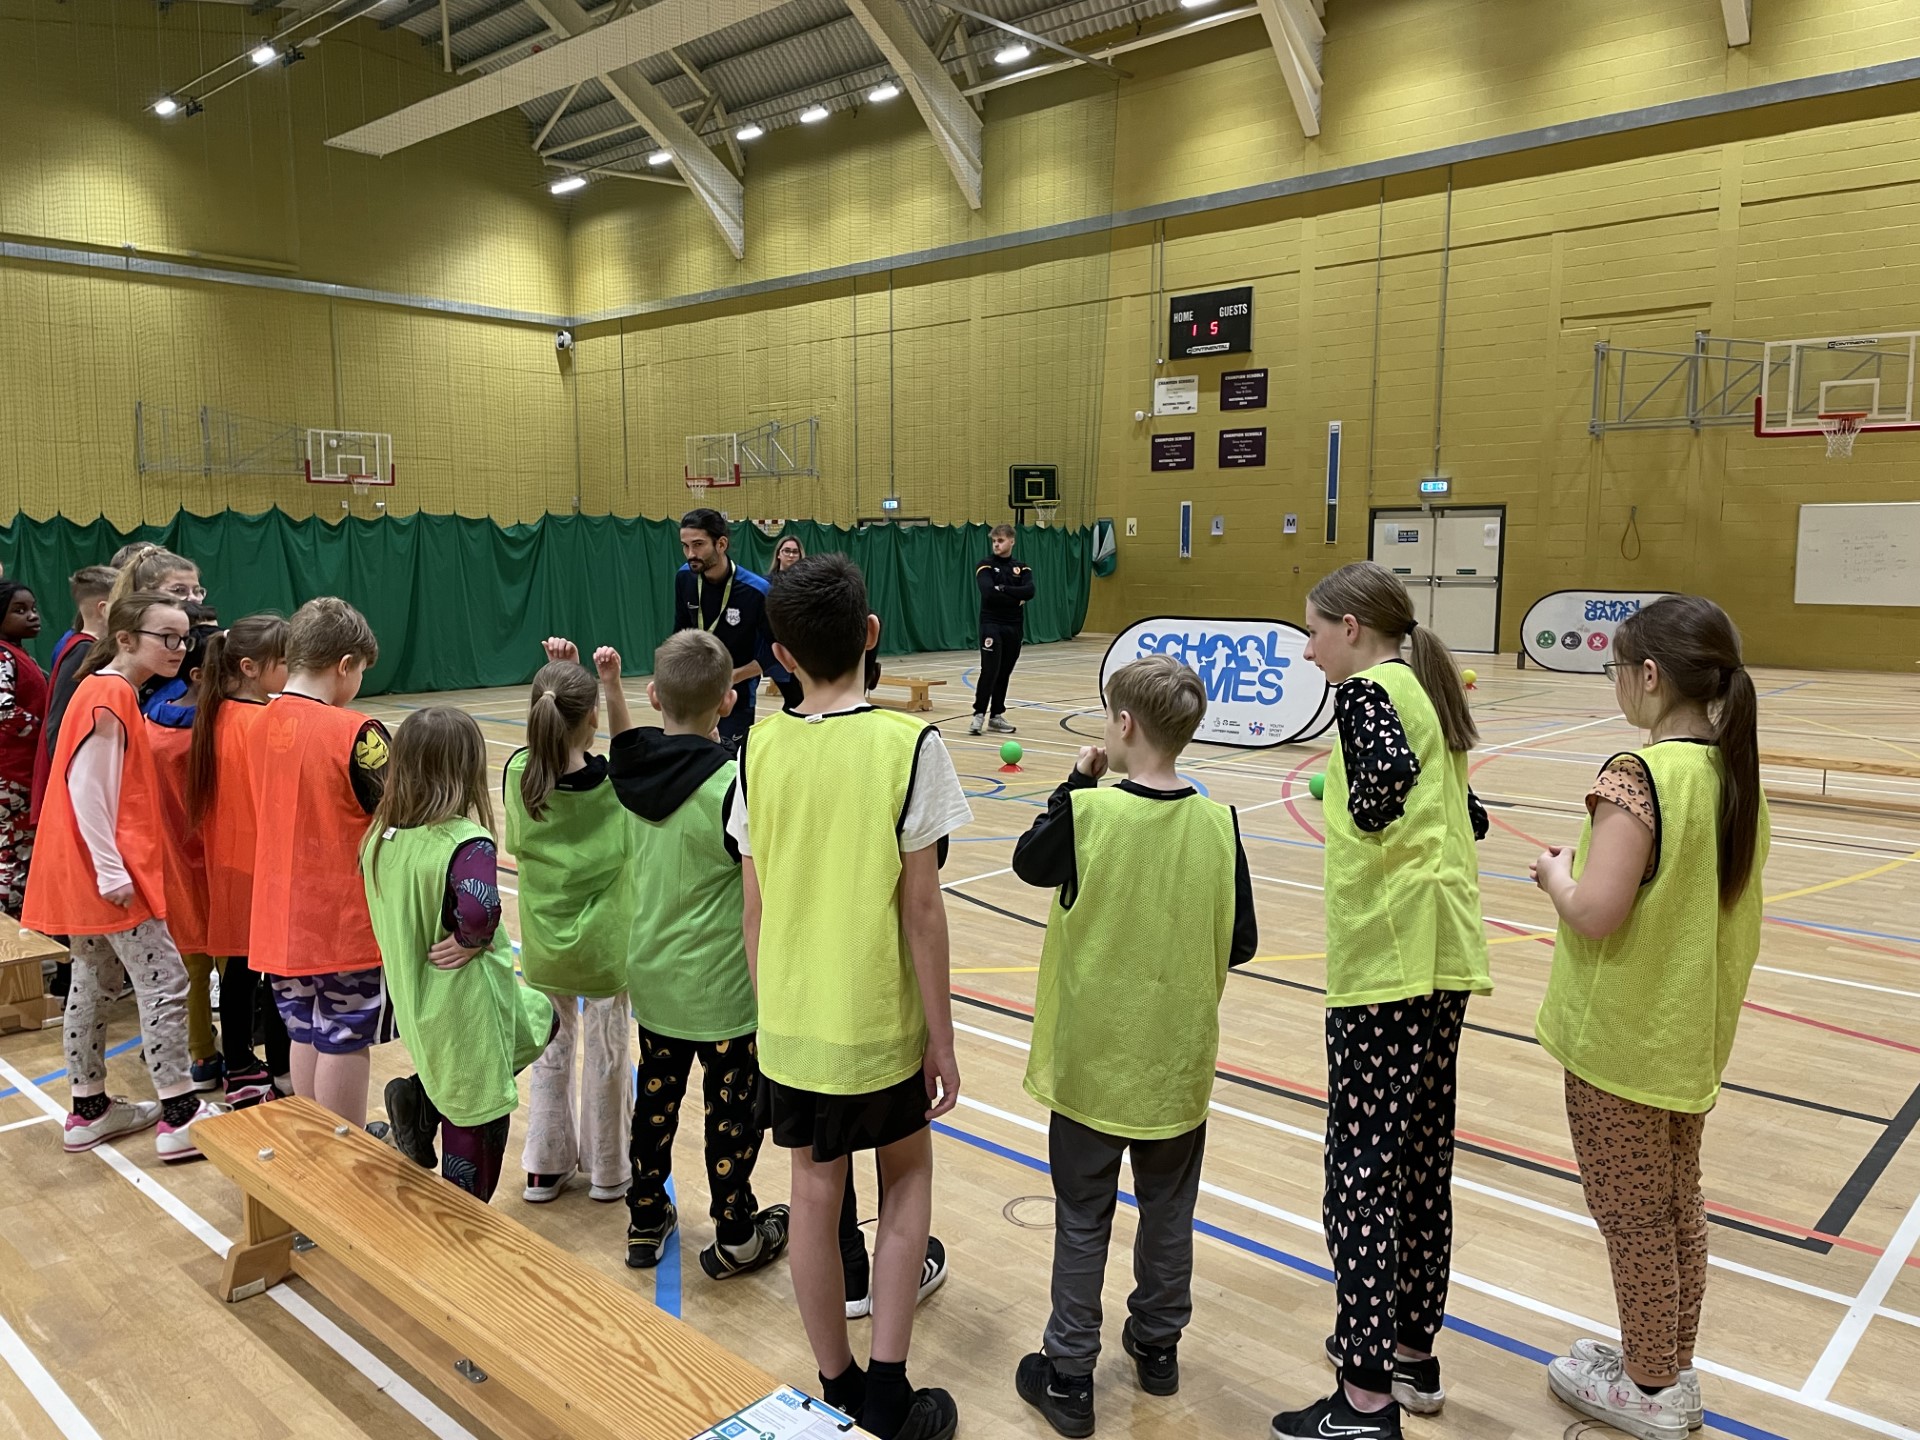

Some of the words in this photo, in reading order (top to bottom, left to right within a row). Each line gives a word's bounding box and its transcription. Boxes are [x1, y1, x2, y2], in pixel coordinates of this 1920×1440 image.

[1173, 310, 1194, 323] HOME
[1219, 303, 1248, 317] GUESTS
[1210, 321, 1218, 335] 5
[1186, 343, 1230, 354] CONTINENTAL
[1215, 520, 1221, 529] L
[1286, 518, 1296, 527] M
[1128, 524, 1136, 535] K
[1136, 630, 1291, 668] SCHOOL
[1199, 664, 1284, 706] MES
